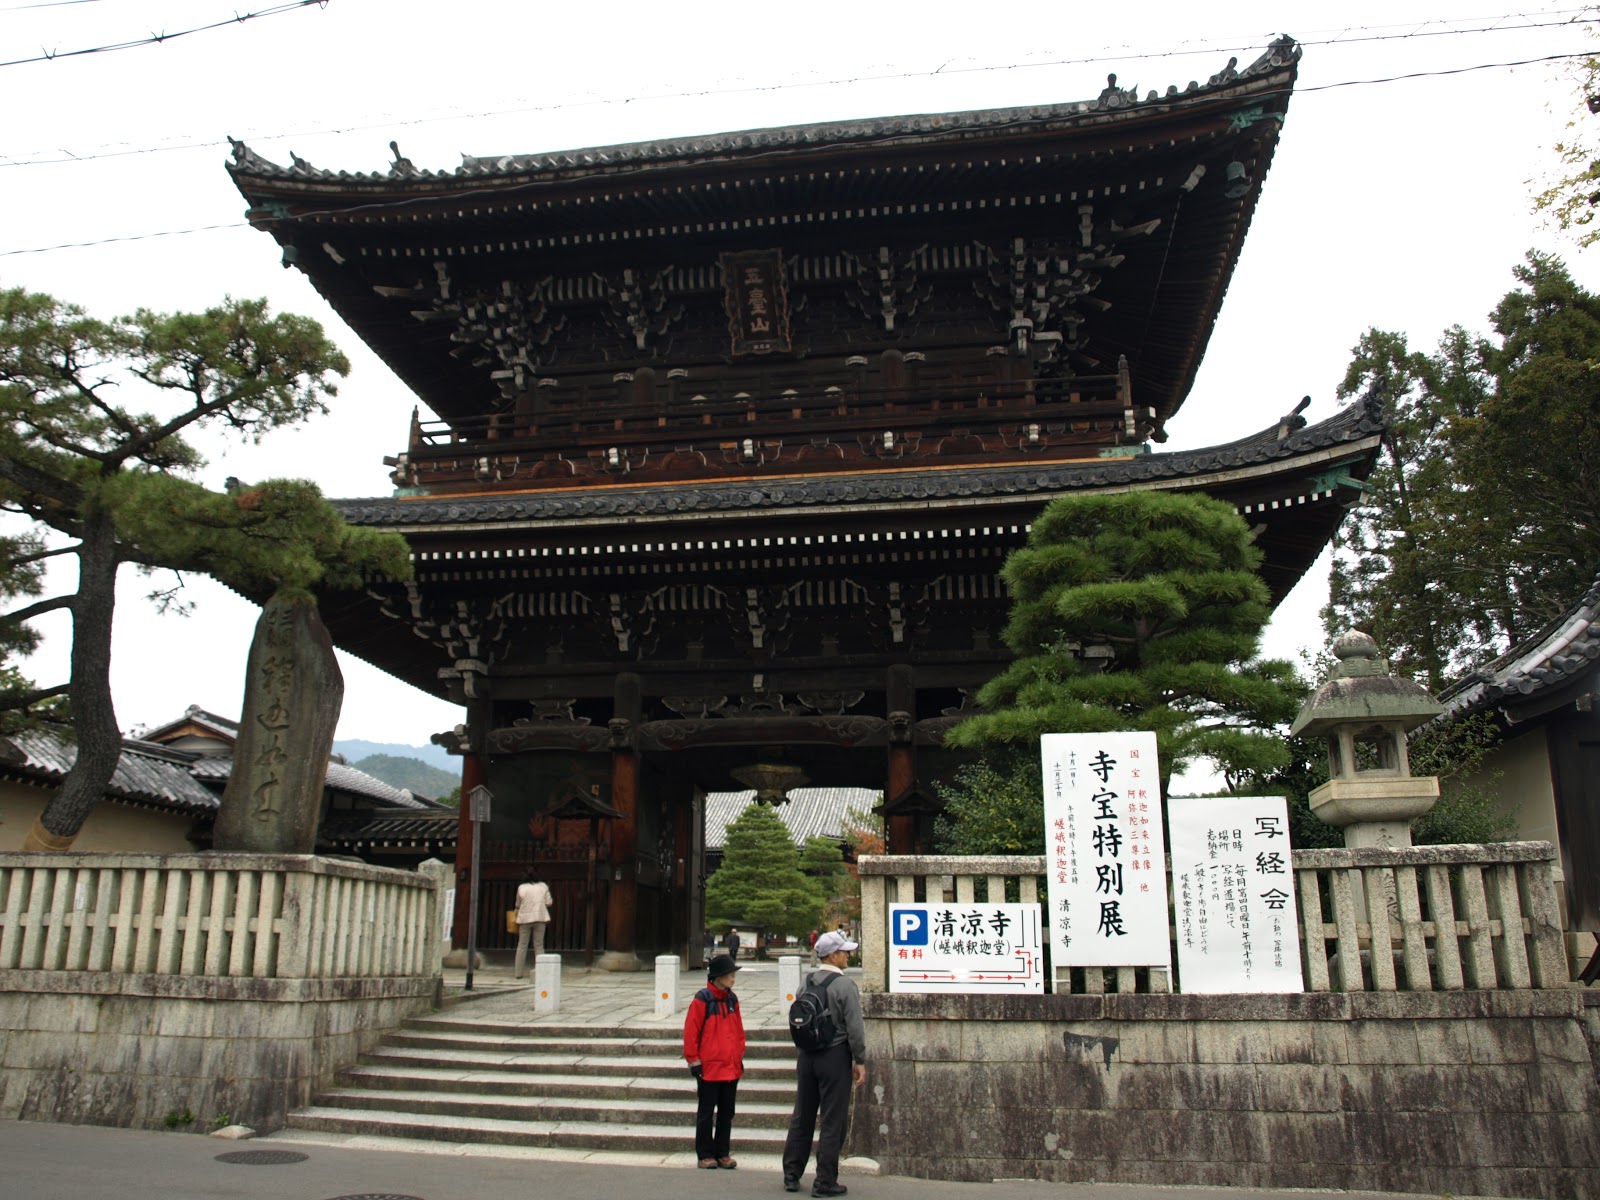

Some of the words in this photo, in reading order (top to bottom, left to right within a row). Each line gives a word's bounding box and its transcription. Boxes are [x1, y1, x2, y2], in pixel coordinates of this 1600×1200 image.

[1130, 749, 1140, 778] 国宝
[1127, 789, 1140, 870] 阿弥陀三尊像
[1218, 829, 1230, 852] 場所
[1232, 829, 1243, 852] 日時
[1088, 750, 1128, 938] 寺宝特別展
[1254, 817, 1289, 909] 写経会
[900, 914, 921, 941] P
[898, 948, 923, 960] 有料
